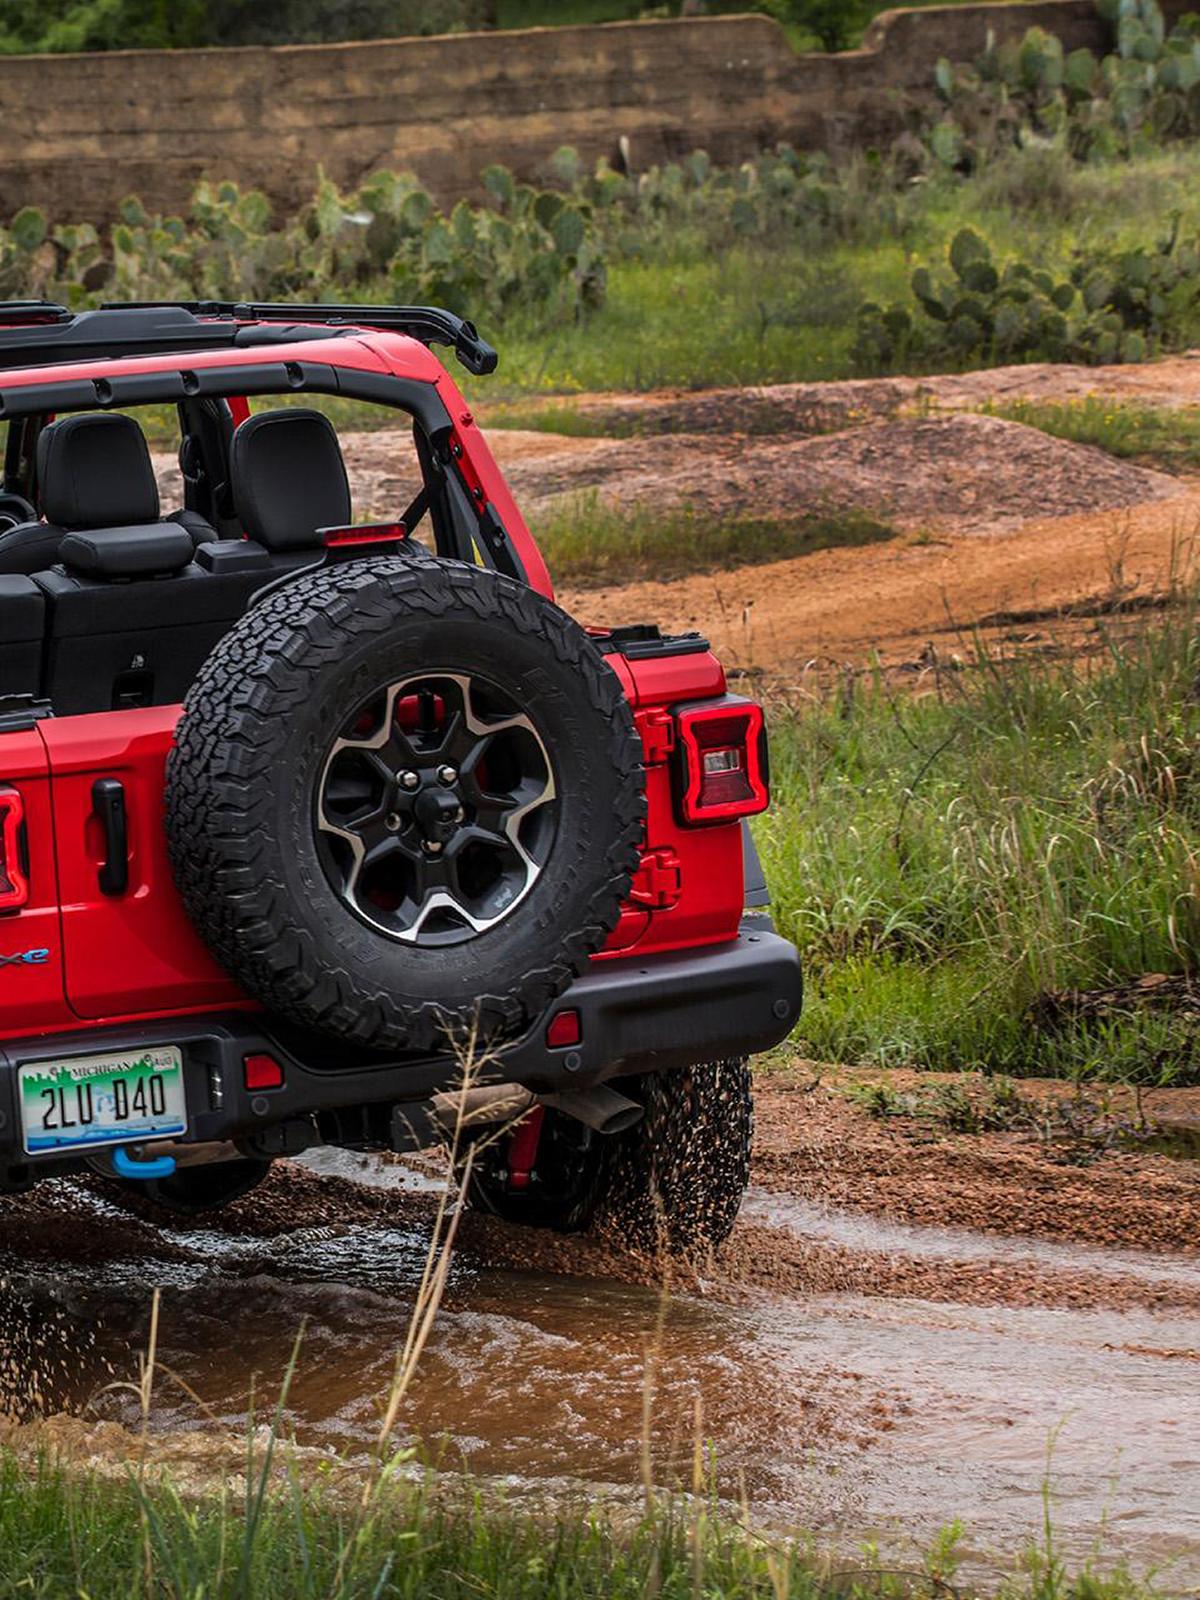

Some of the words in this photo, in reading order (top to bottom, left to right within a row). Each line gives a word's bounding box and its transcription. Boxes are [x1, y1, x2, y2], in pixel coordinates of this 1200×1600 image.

[72, 1060, 131, 1077] MICHIGAN
[41, 1083, 93, 1130] 2LU
[113, 1074, 165, 1121] D40
